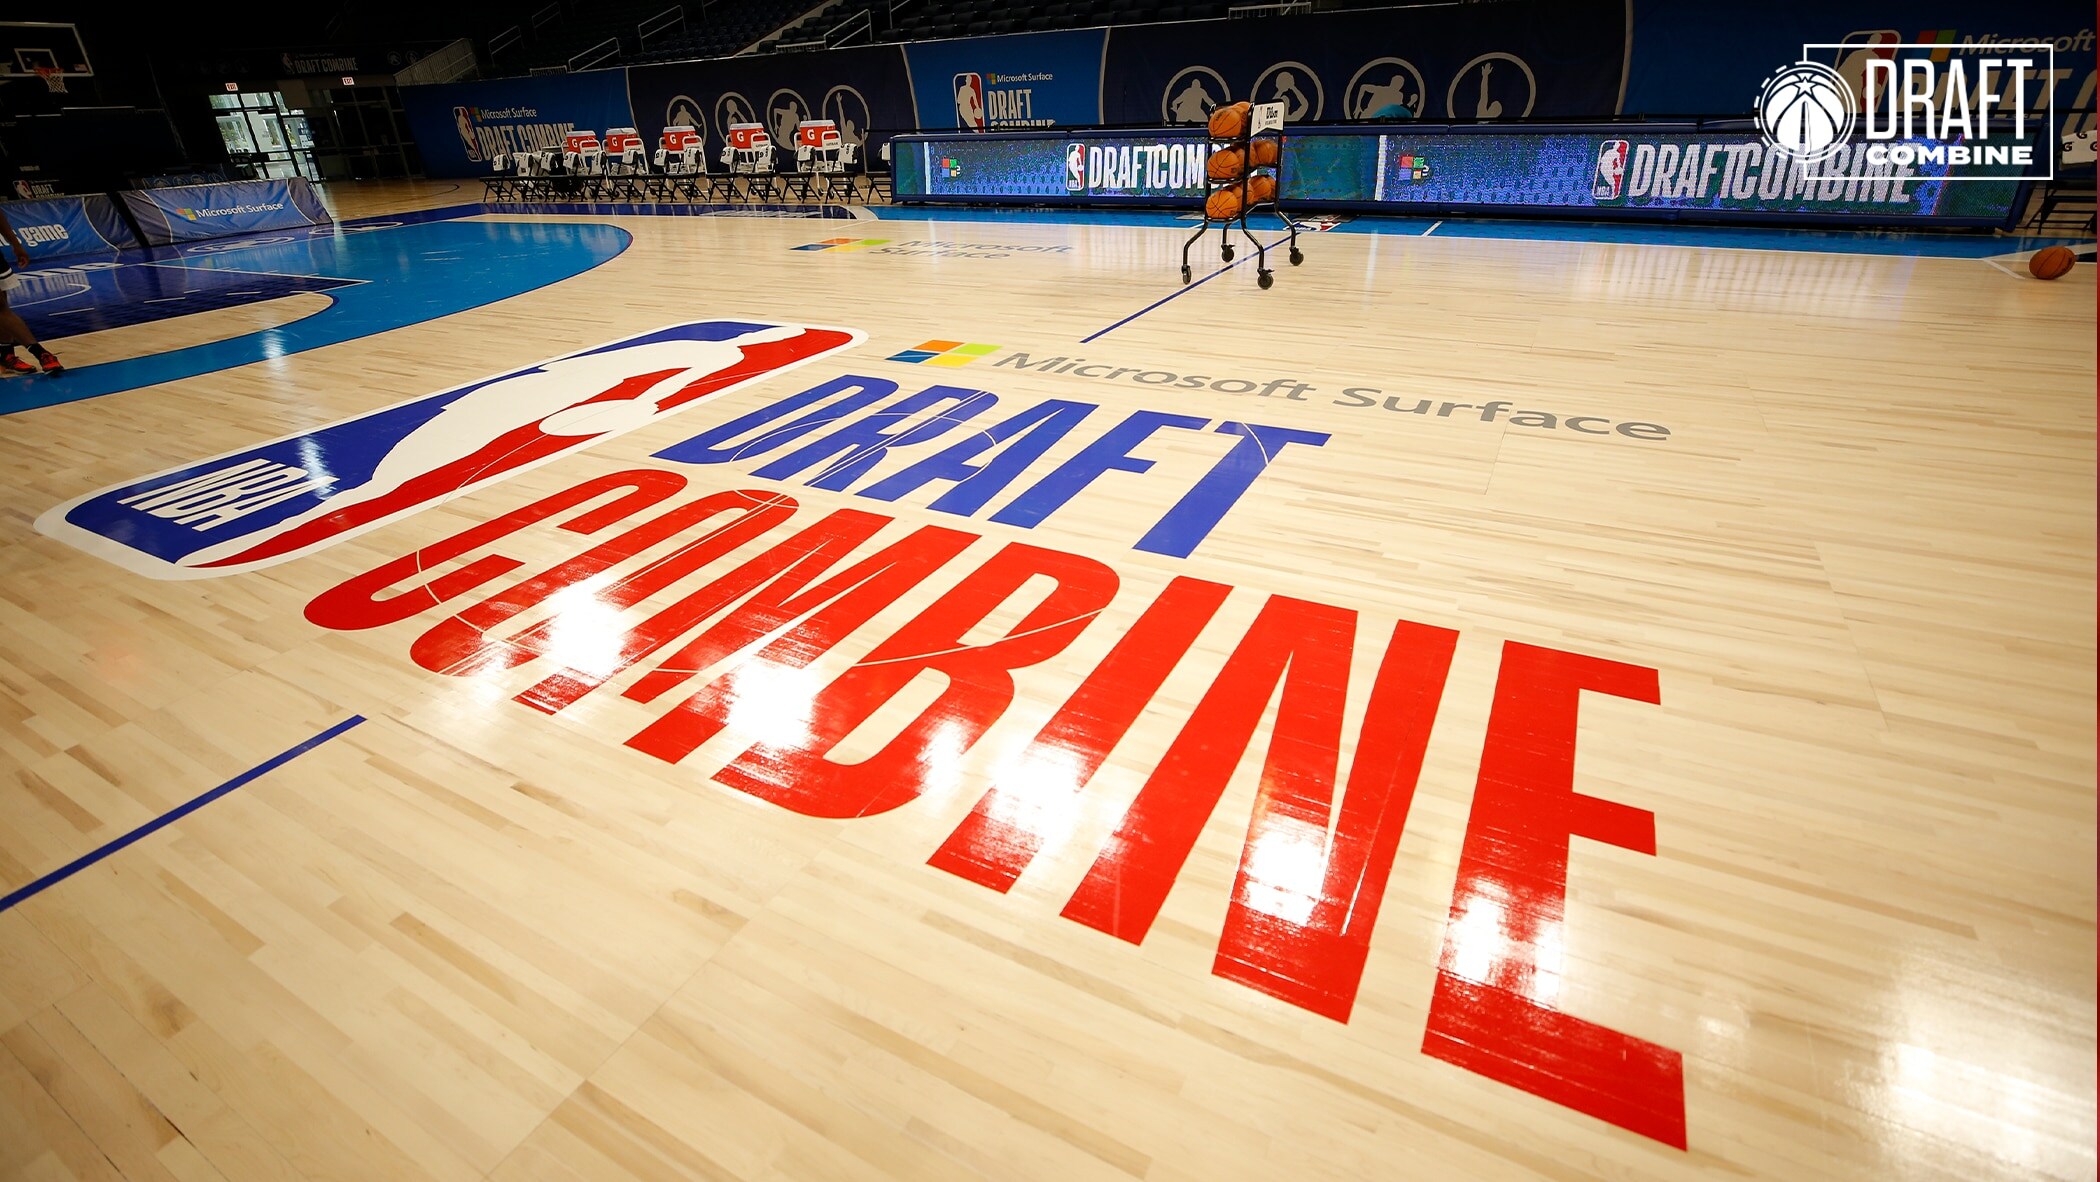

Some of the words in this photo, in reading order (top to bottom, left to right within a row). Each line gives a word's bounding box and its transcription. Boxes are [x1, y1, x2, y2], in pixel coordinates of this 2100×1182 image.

[1959, 28, 2097, 57] Microsoft
[295, 58, 321, 74] DRAFT
[997, 74, 1027, 84] Microsoft
[1028, 72, 1053, 82] Surface
[988, 89, 1032, 120] DRAFT
[481, 108, 511, 120] Microsoft
[512, 106, 538, 119] Surface
[476, 125, 514, 161] DRAFT
[517, 123, 575, 154] COMBIN
[571, 138, 579, 148] G
[612, 137, 619, 147] G
[669, 134, 678, 145] G
[736, 131, 745, 143] G
[807, 129, 816, 141] G
[196, 206, 245, 218] Microsoft
[246, 201, 284, 213] Surface
[18, 224, 69, 247] game
[869, 247, 1012, 260] Surface
[898, 240, 1074, 255] Microsoft
[993, 352, 1317, 402] Microsoft
[1333, 387, 1672, 442] Surface
[651, 375, 1332, 559] DRAFT
[118, 458, 340, 532] NBA
[304, 469, 1688, 1151] COMBINE
